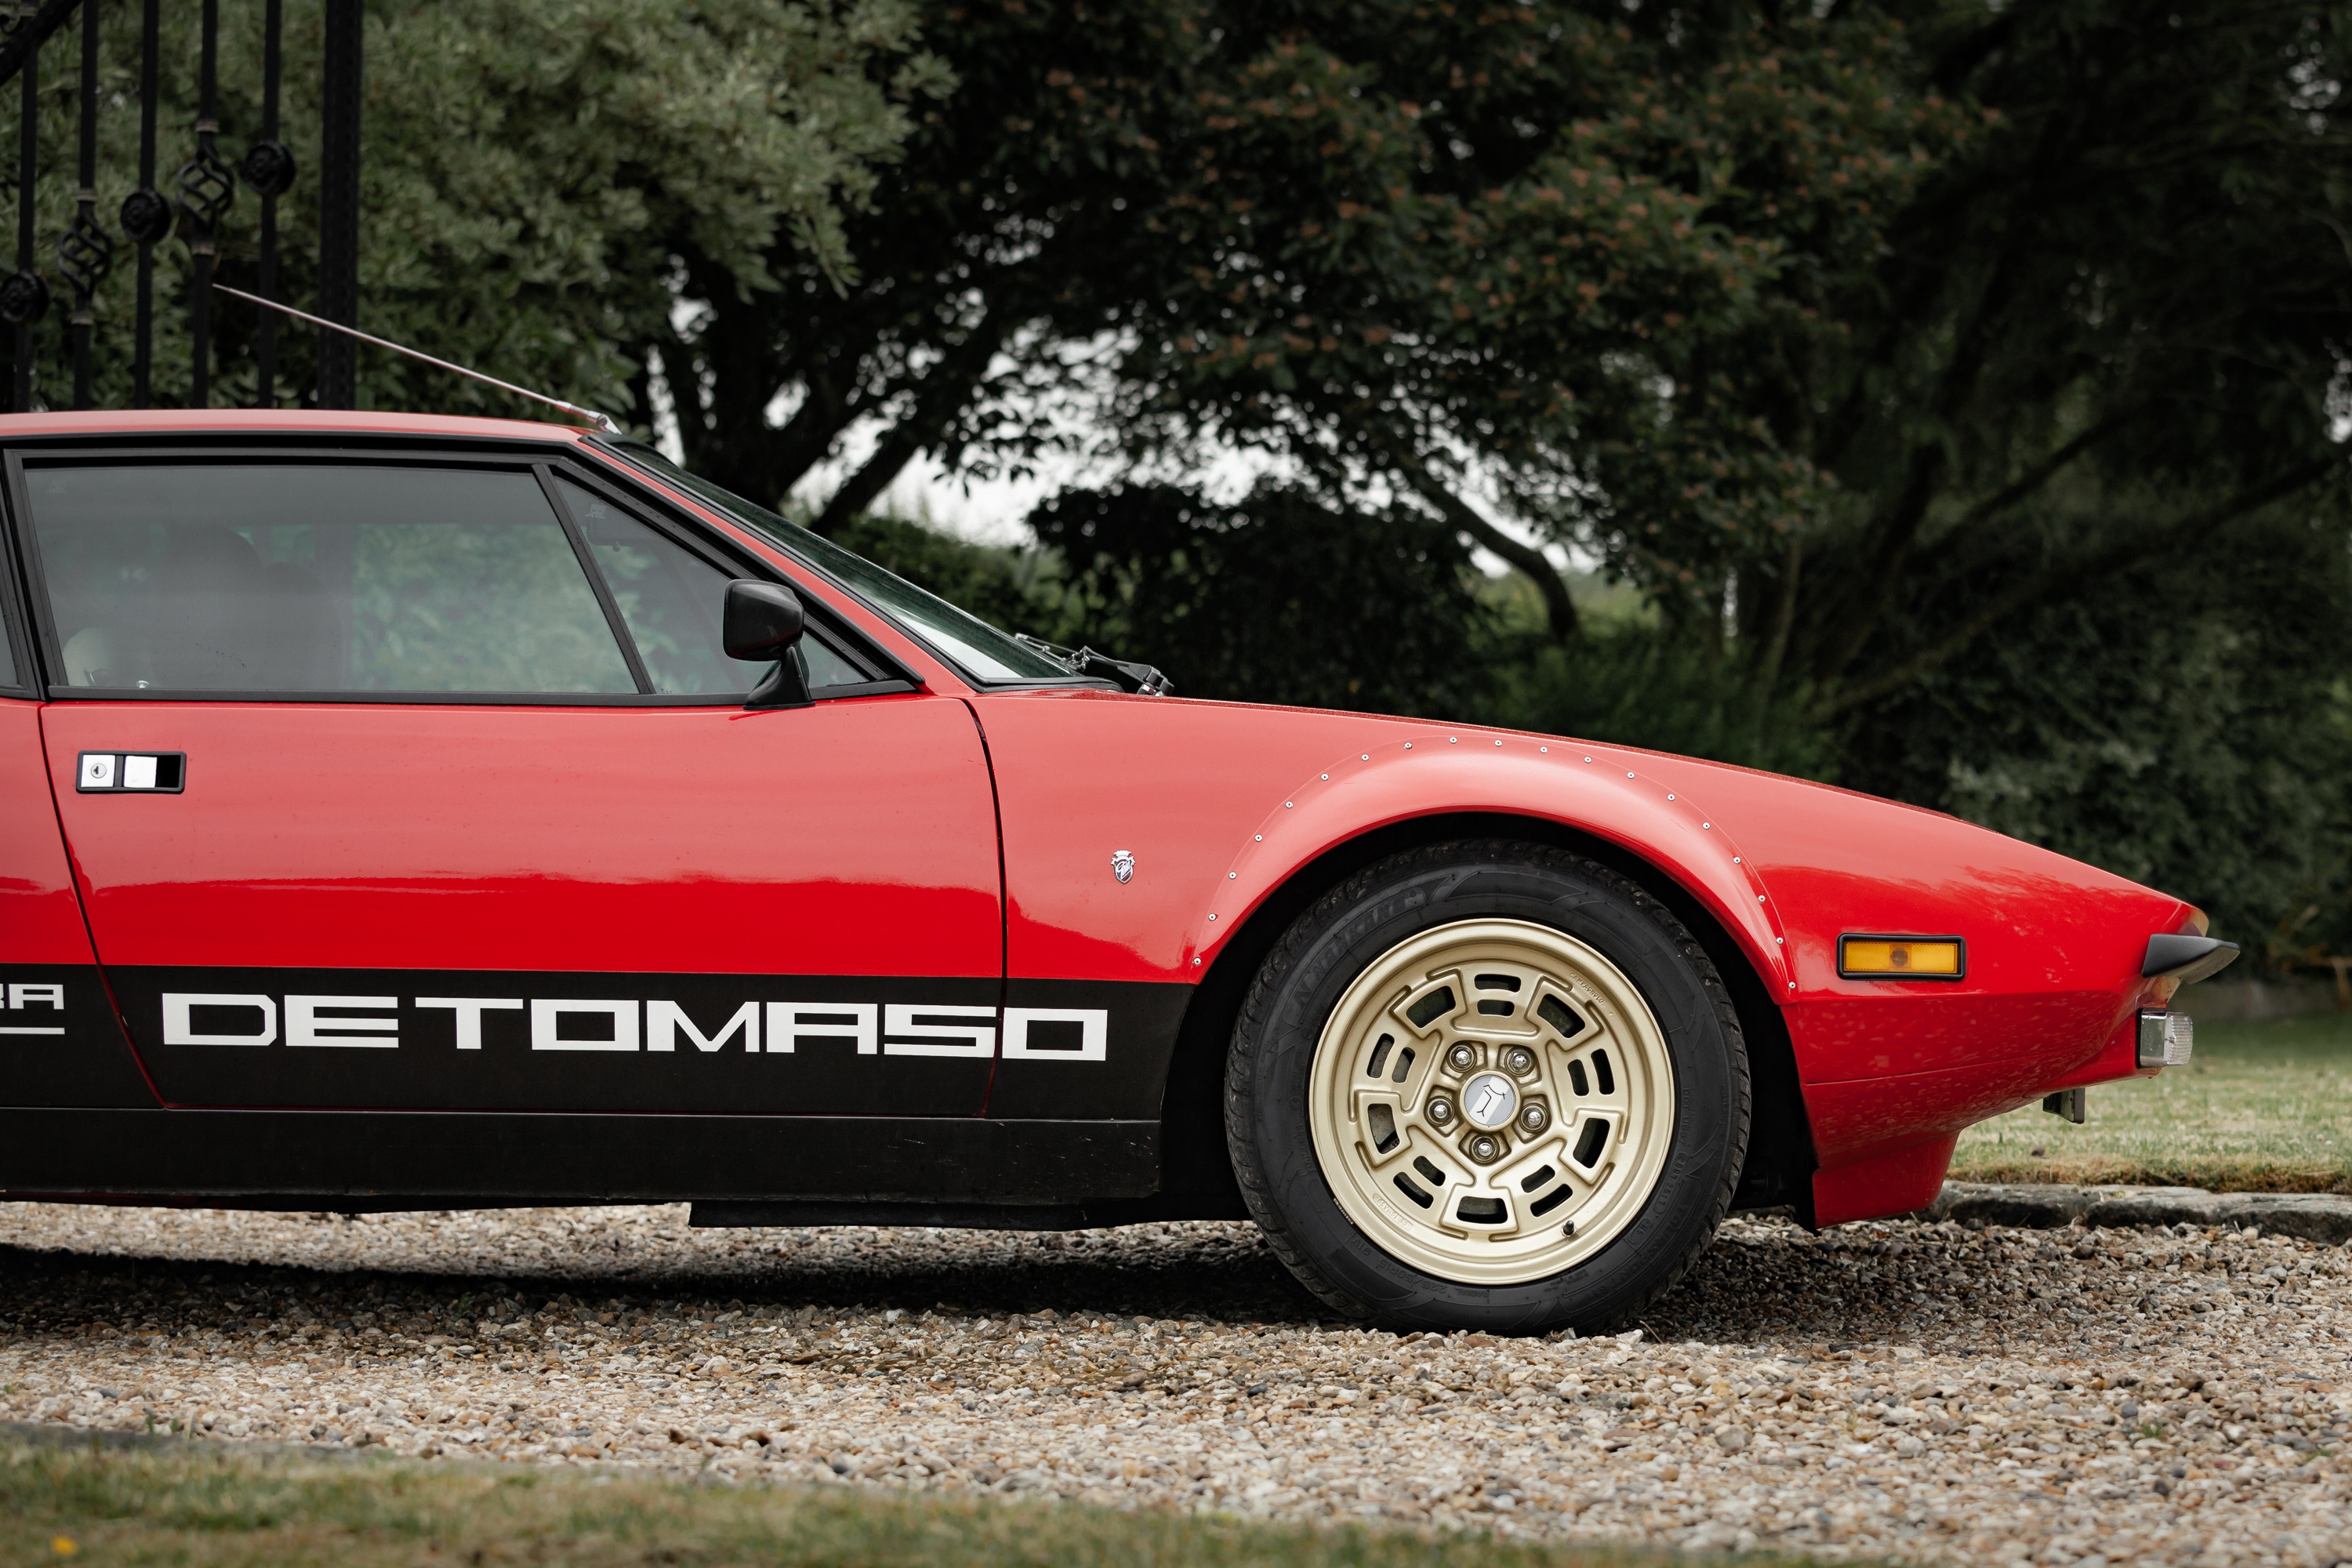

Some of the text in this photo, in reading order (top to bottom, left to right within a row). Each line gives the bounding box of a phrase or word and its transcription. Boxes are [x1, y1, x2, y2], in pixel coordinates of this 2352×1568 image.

[1306, 895, 1406, 981] NANKANG
[1569, 972, 1604, 1004] CAMPAGNOLO
[1349, 1236, 1489, 1298] RADIAL 225/50R15 91V
